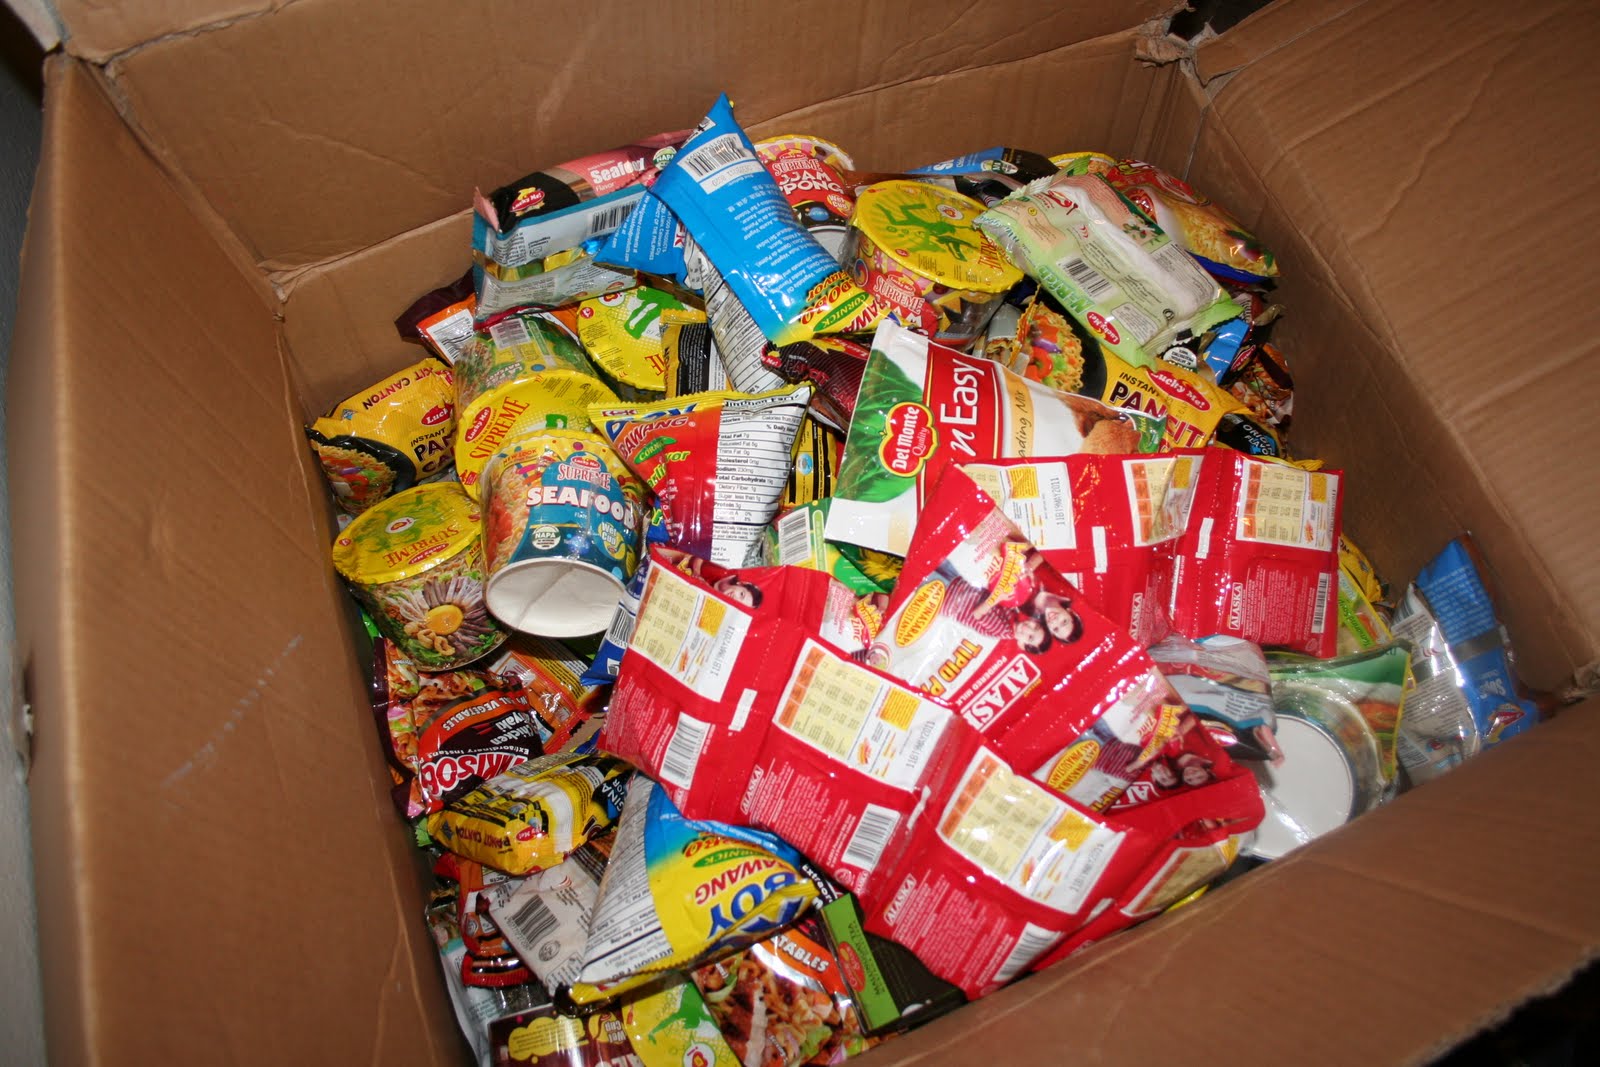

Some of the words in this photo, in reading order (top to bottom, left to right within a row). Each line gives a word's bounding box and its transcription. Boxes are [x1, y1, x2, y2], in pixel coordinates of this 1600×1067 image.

[772, 159, 823, 177] SUPREME
[780, 181, 843, 195] PONG
[802, 279, 853, 324] DOBO
[940, 358, 985, 426] Easy
[425, 406, 450, 424] Luck
[470, 396, 530, 460] SUPREME
[410, 427, 446, 447] INSTANT
[618, 417, 687, 459] BAWANG
[892, 445, 908, 471] Del
[900, 405, 920, 445] Monte
[911, 426, 929, 457] Quality
[1018, 415, 1032, 458] ading
[1243, 435, 1268, 455] FLAVO
[557, 462, 612, 491] SUPREME
[382, 523, 460, 569] SUPREME
[938, 638, 983, 680] TIPID
[972, 655, 1007, 690] POWDERED
[956, 686, 976, 706] MILK
[963, 659, 1031, 729] ALAS
[441, 699, 499, 730] VEGETABLES
[695, 859, 787, 905] AWANG
[802, 864, 838, 902] Extraor
[886, 876, 915, 925] ALASKA
[777, 937, 829, 973] TABLES
